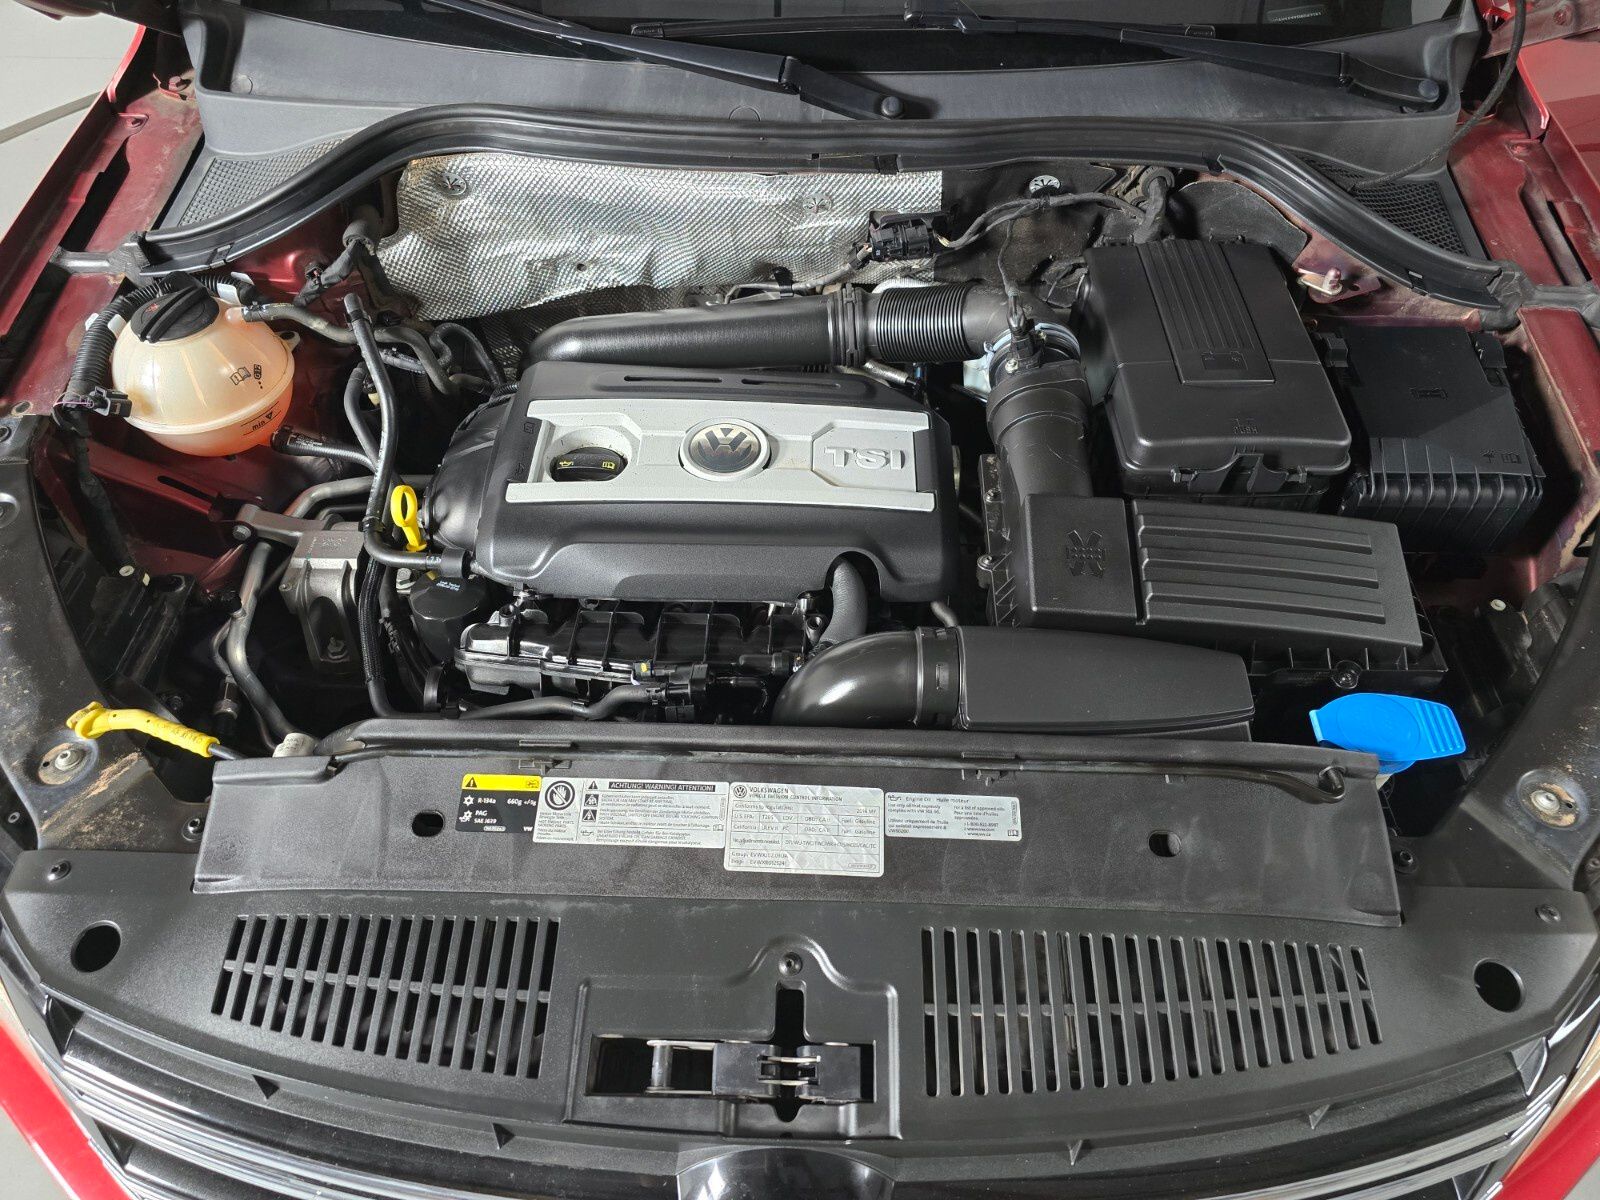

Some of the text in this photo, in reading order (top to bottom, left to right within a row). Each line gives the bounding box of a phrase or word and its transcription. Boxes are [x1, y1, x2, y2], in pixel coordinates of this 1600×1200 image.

[252, 420, 266, 431] min
[824, 446, 905, 471] TSI
[678, 784, 714, 792] ATTENTION!
[507, 798, 523, 807] 660g
